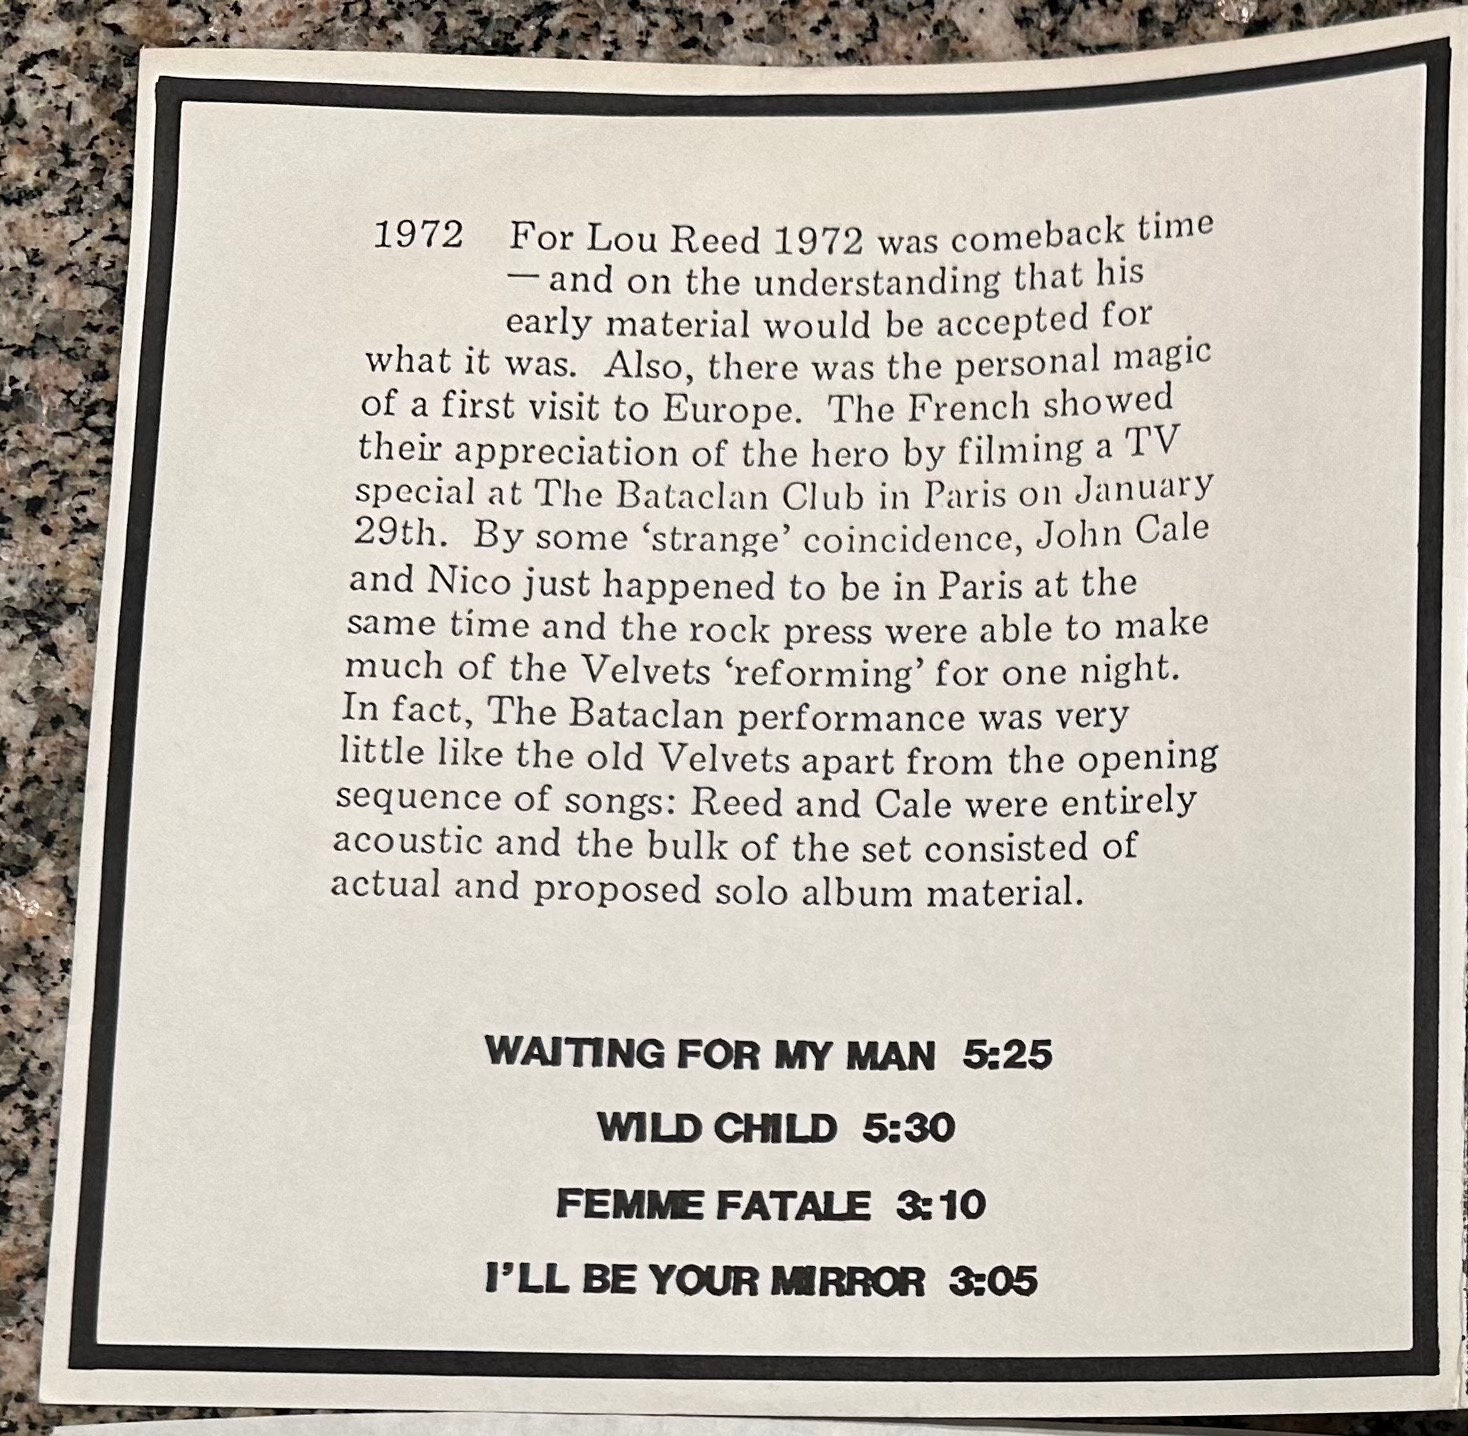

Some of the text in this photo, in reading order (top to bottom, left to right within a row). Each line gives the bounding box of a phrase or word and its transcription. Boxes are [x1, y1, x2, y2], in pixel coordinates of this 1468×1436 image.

[374, 209, 1215, 256] 1972 For Lou Reed 1972 was comeback time
[626, 273, 672, 296] on
[685, 264, 741, 297] the
[754, 262, 1002, 300] understanding
[1013, 259, 1084, 292] that
[1096, 252, 1144, 287] his
[505, 295, 1154, 342] early material would be accepted for
[364, 334, 1212, 387] what it was. Also, there was the personal magic
[360, 379, 1174, 431] of a first visit to Europe. The French showed
[358, 422, 1182, 473] their appreciation of the hero by filming a TV
[354, 471, 1215, 512] special at The Bataclan Club in Paris on January
[354, 514, 448, 548] 29th.
[472, 517, 525, 555] By
[535, 527, 629, 552] some
[803, 522, 1023, 558] coincidence,
[1035, 517, 1122, 550] John
[1135, 508, 1210, 545] Cale
[348, 562, 1138, 607] and Nico just happened to be in Paris at the
[346, 605, 1209, 652] same time and the rock press were able to make
[344, 647, 444, 680] much
[457, 651, 497, 681] of
[509, 651, 568, 683] the
[580, 651, 712, 686] Velvets
[935, 656, 990, 688] for
[1002, 663, 1067, 687] one
[1080, 650, 1180, 690] night.
[341, 690, 1131, 738] In fact, The Bataclan performance was very
[339, 733, 1220, 782] little like the old Velvets apart from the opening
[335, 781, 1198, 822] sequence of songs: Reed and Cale were entirely
[332, 824, 1140, 864] acoustic and the bulk of the set consisted of
[330, 866, 1084, 909] actual and proposed solo album material.
[483, 1033, 1054, 1072] WAITING FOR MY MAN 5:25
[595, 1110, 957, 1145] WILD CHILD 5:30
[555, 1186, 987, 1224] FEMME FATALE 3:10
[581, 1262, 639, 1296] BE
[647, 1263, 761, 1297] YOUR
[769, 1264, 927, 1299] MIRROR
[948, 1263, 1039, 1298] 3:05
